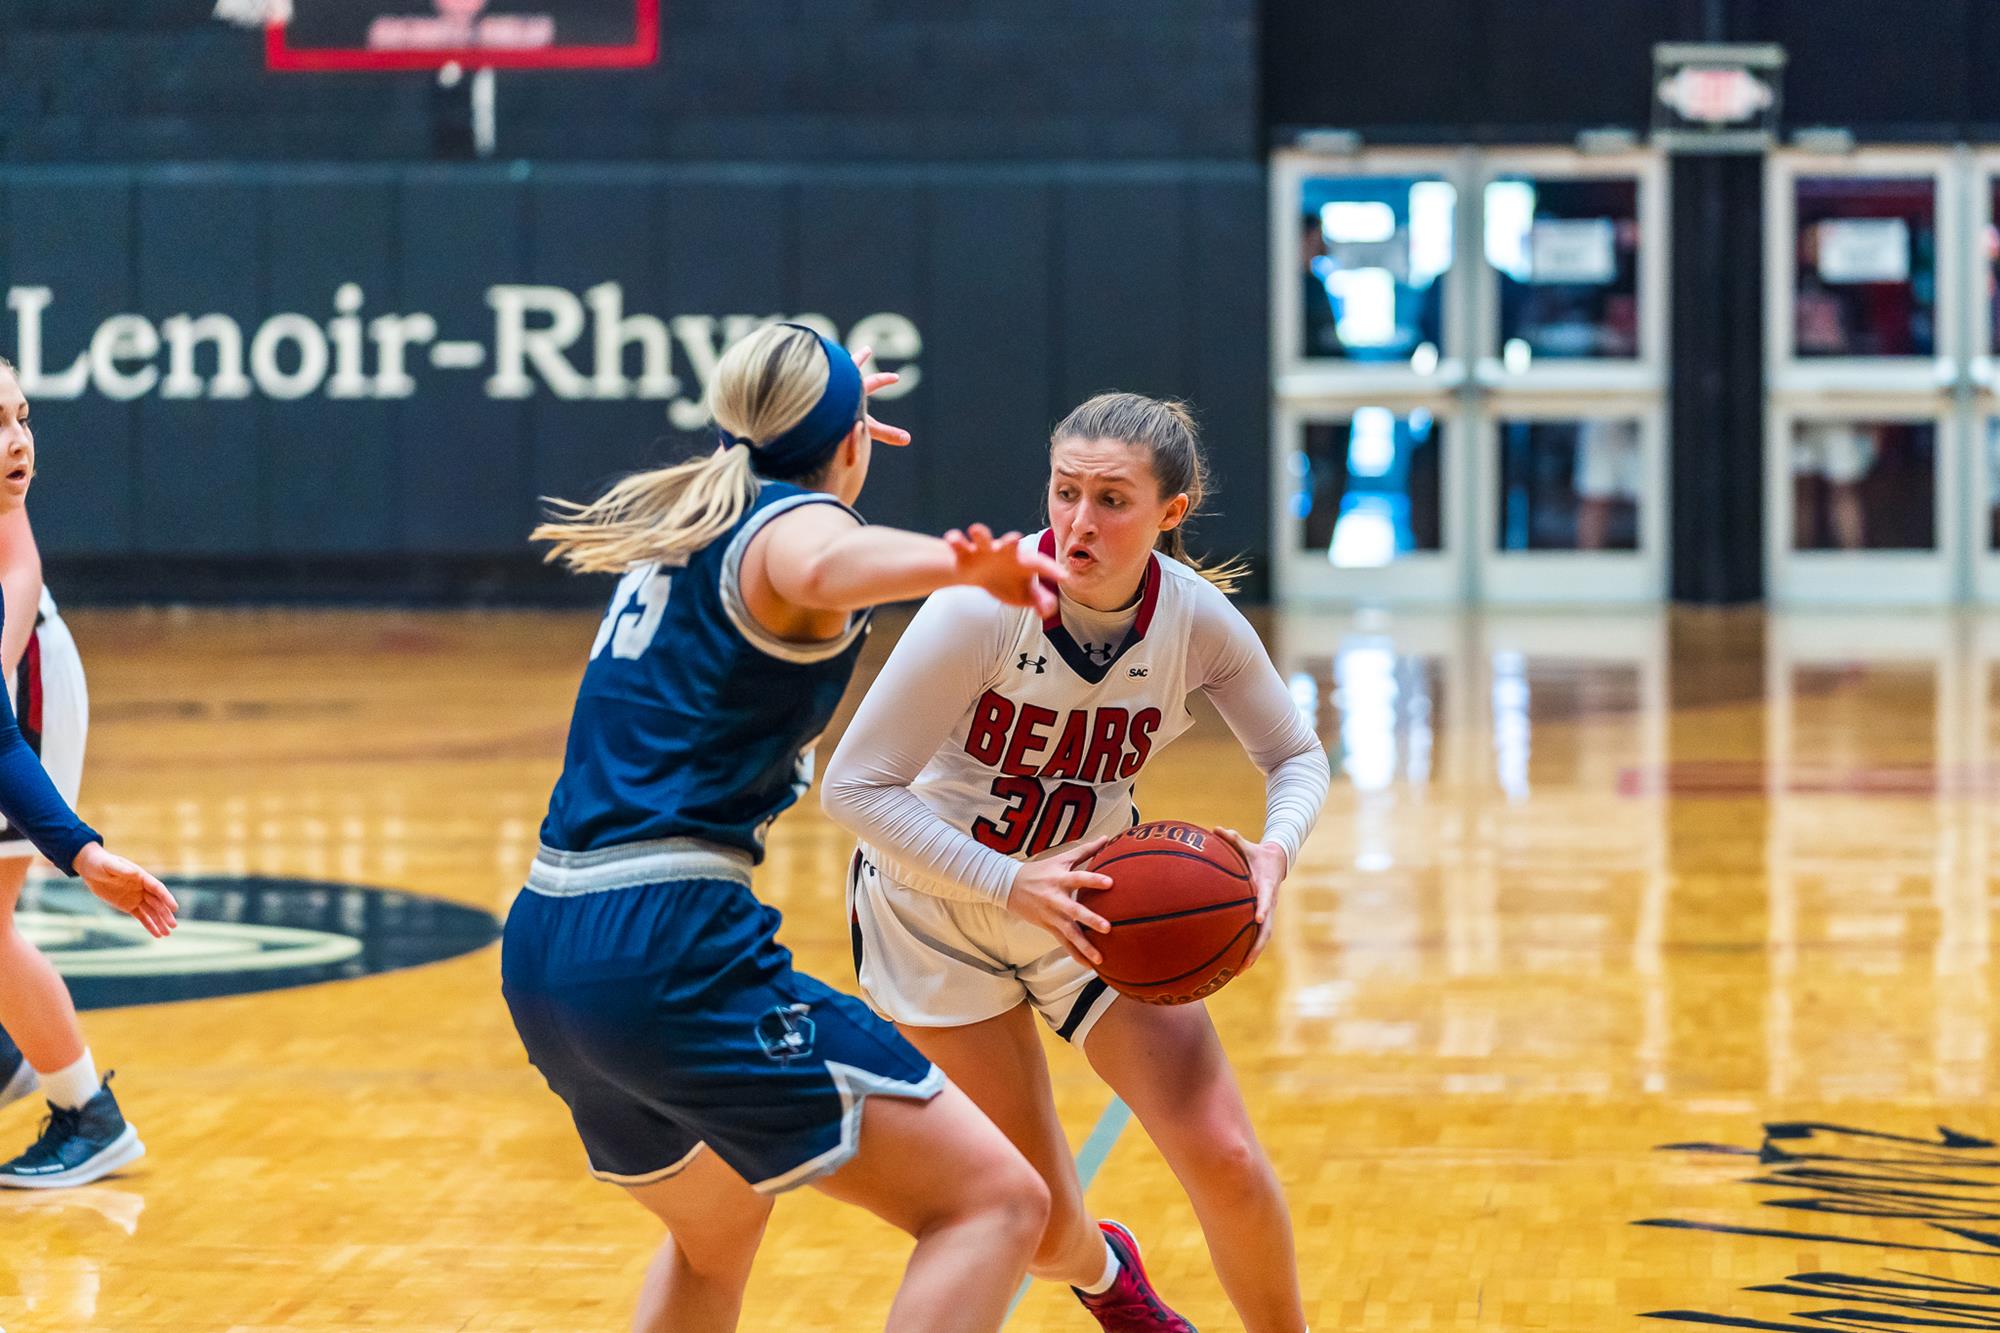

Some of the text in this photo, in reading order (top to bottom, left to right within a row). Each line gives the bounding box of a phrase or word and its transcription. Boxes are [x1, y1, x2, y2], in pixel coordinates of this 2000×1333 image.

[6, 282, 923, 431] Lenoir-Rhye
[1129, 668, 1149, 677] SAC
[964, 688, 1162, 784] BEARS
[971, 775, 1098, 858] 30
[1108, 823, 1207, 853] Wils
